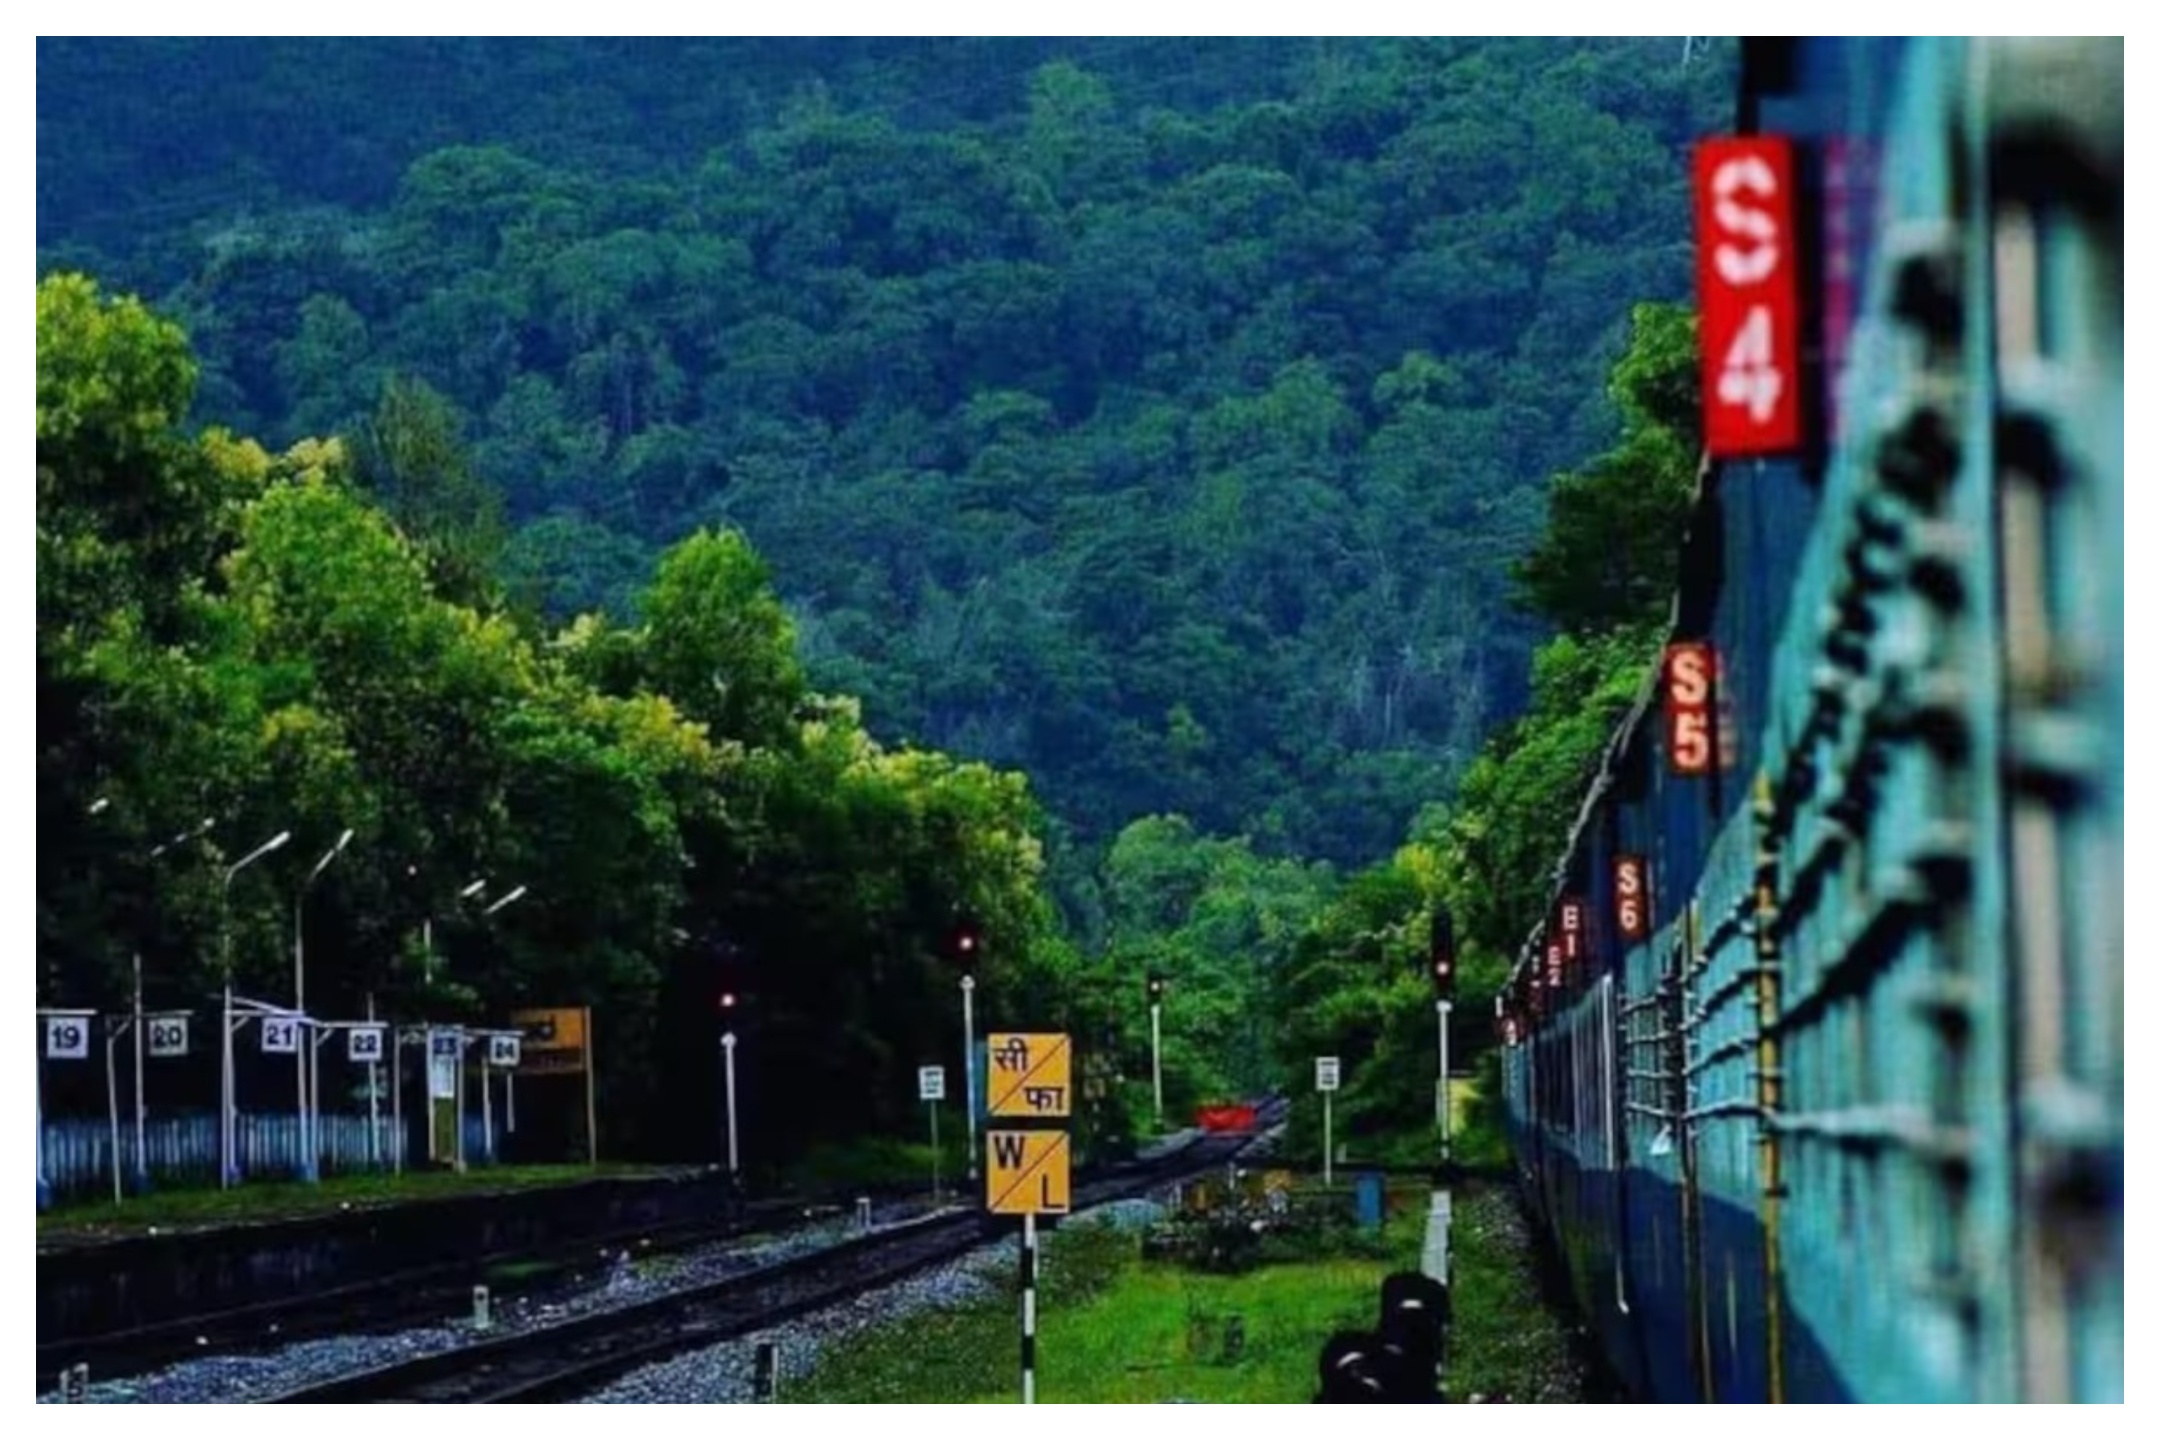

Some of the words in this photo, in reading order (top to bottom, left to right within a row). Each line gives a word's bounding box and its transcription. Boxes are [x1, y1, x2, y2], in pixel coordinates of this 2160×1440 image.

[1711, 156, 1782, 422] S4
[1671, 651, 1708, 767] S5
[1617, 863, 1638, 930] S6
[53, 1026, 79, 1049] 19
[154, 1025, 181, 1047] 20
[266, 1024, 292, 1045] 21
[354, 1034, 377, 1053] 22
[994, 1038, 1028, 1071] सी
[1024, 1087, 1064, 1111] फा
[994, 1136, 1024, 1168] W
[1042, 1174, 1065, 1208] L
